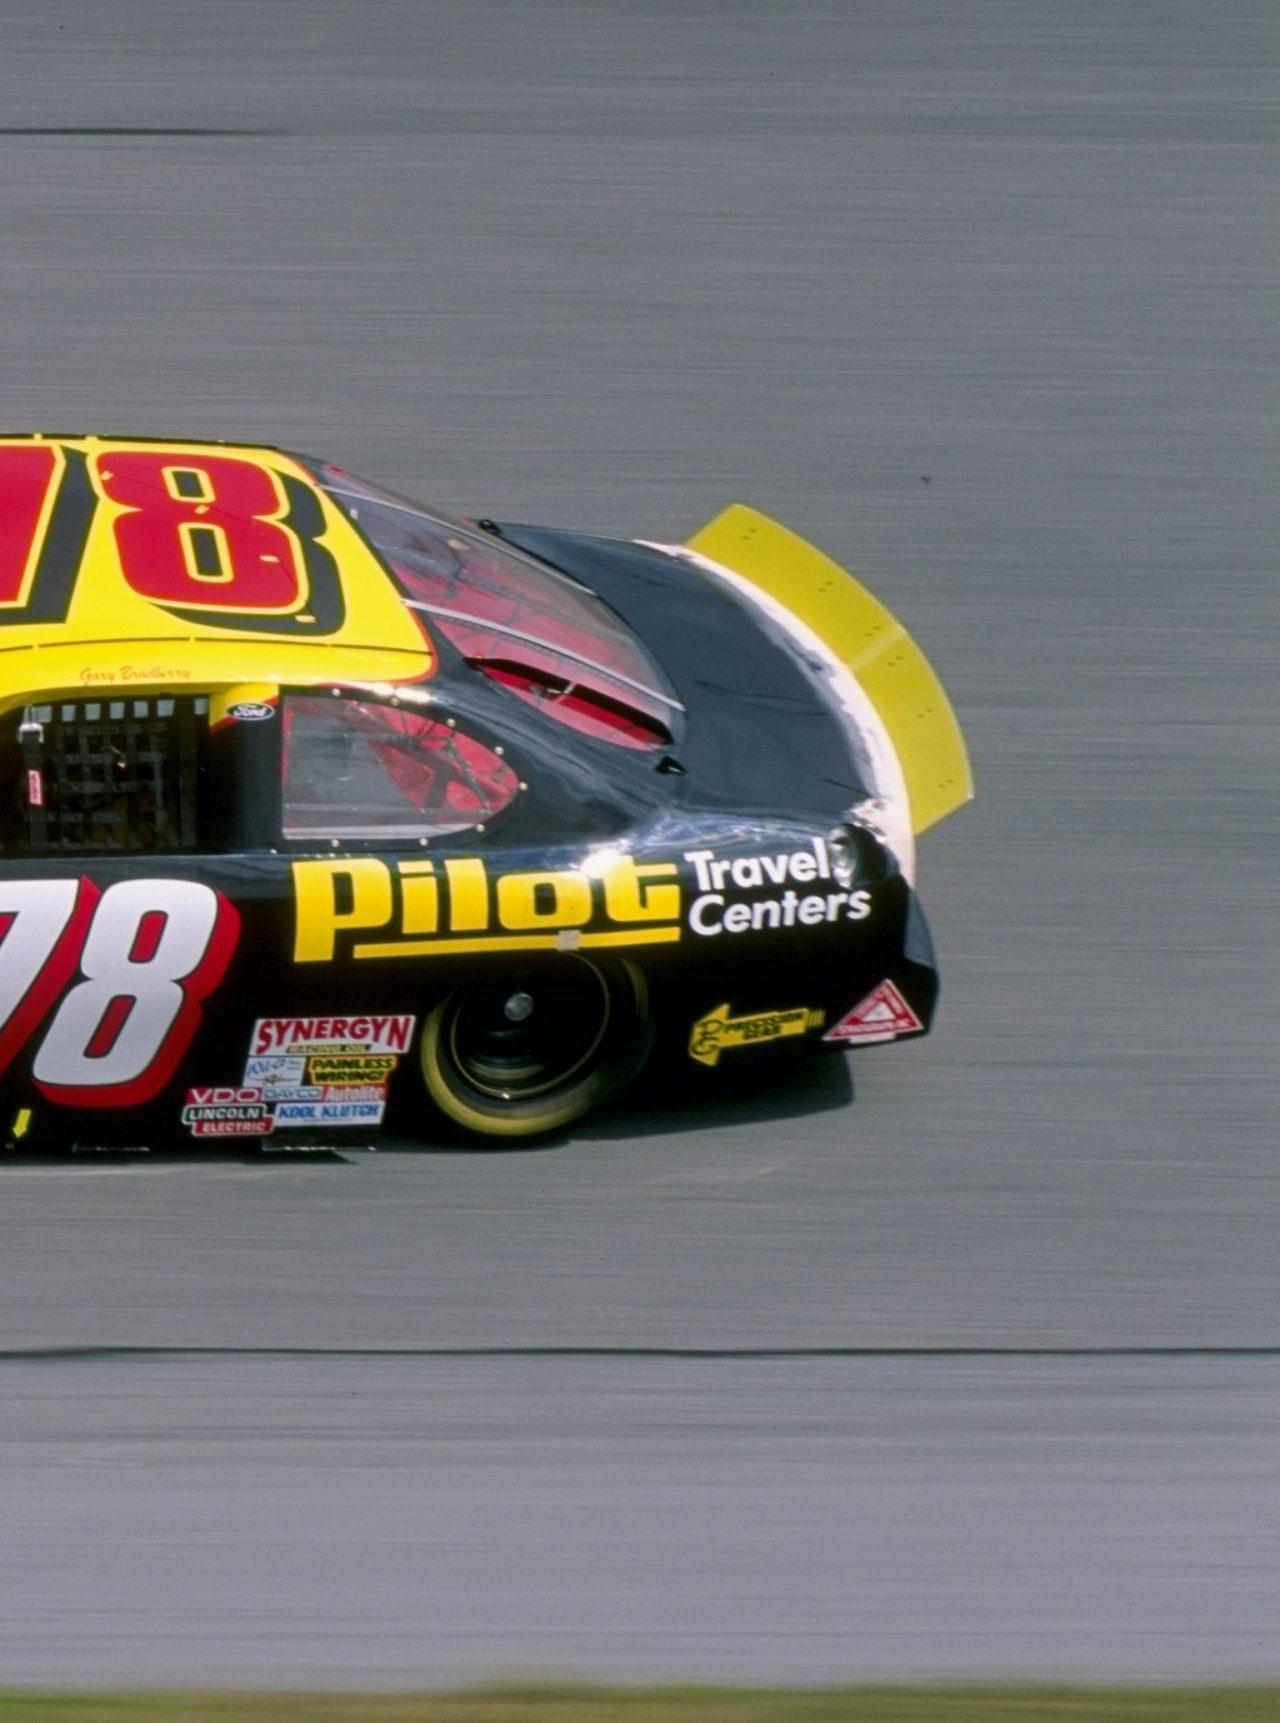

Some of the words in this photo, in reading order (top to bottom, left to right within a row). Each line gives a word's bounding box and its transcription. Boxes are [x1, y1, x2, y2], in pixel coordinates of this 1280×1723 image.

[79, 667, 115, 686] Gary
[231, 704, 269, 719] Ford
[683, 837, 831, 891] Travel
[293, 855, 681, 963] Pilot
[688, 889, 872, 937] Centers
[255, 1016, 412, 1055] SYNERGYN
[312, 1056, 393, 1069] PAINLESS
[190, 1088, 261, 1103] VDO
[263, 1089, 321, 1099] DAYCO
[188, 1105, 261, 1121] LINCOLN
[278, 1105, 316, 1119] KOOL
[321, 1103, 380, 1118] KLUTCH
[202, 1121, 266, 1133] ELECTRIC
